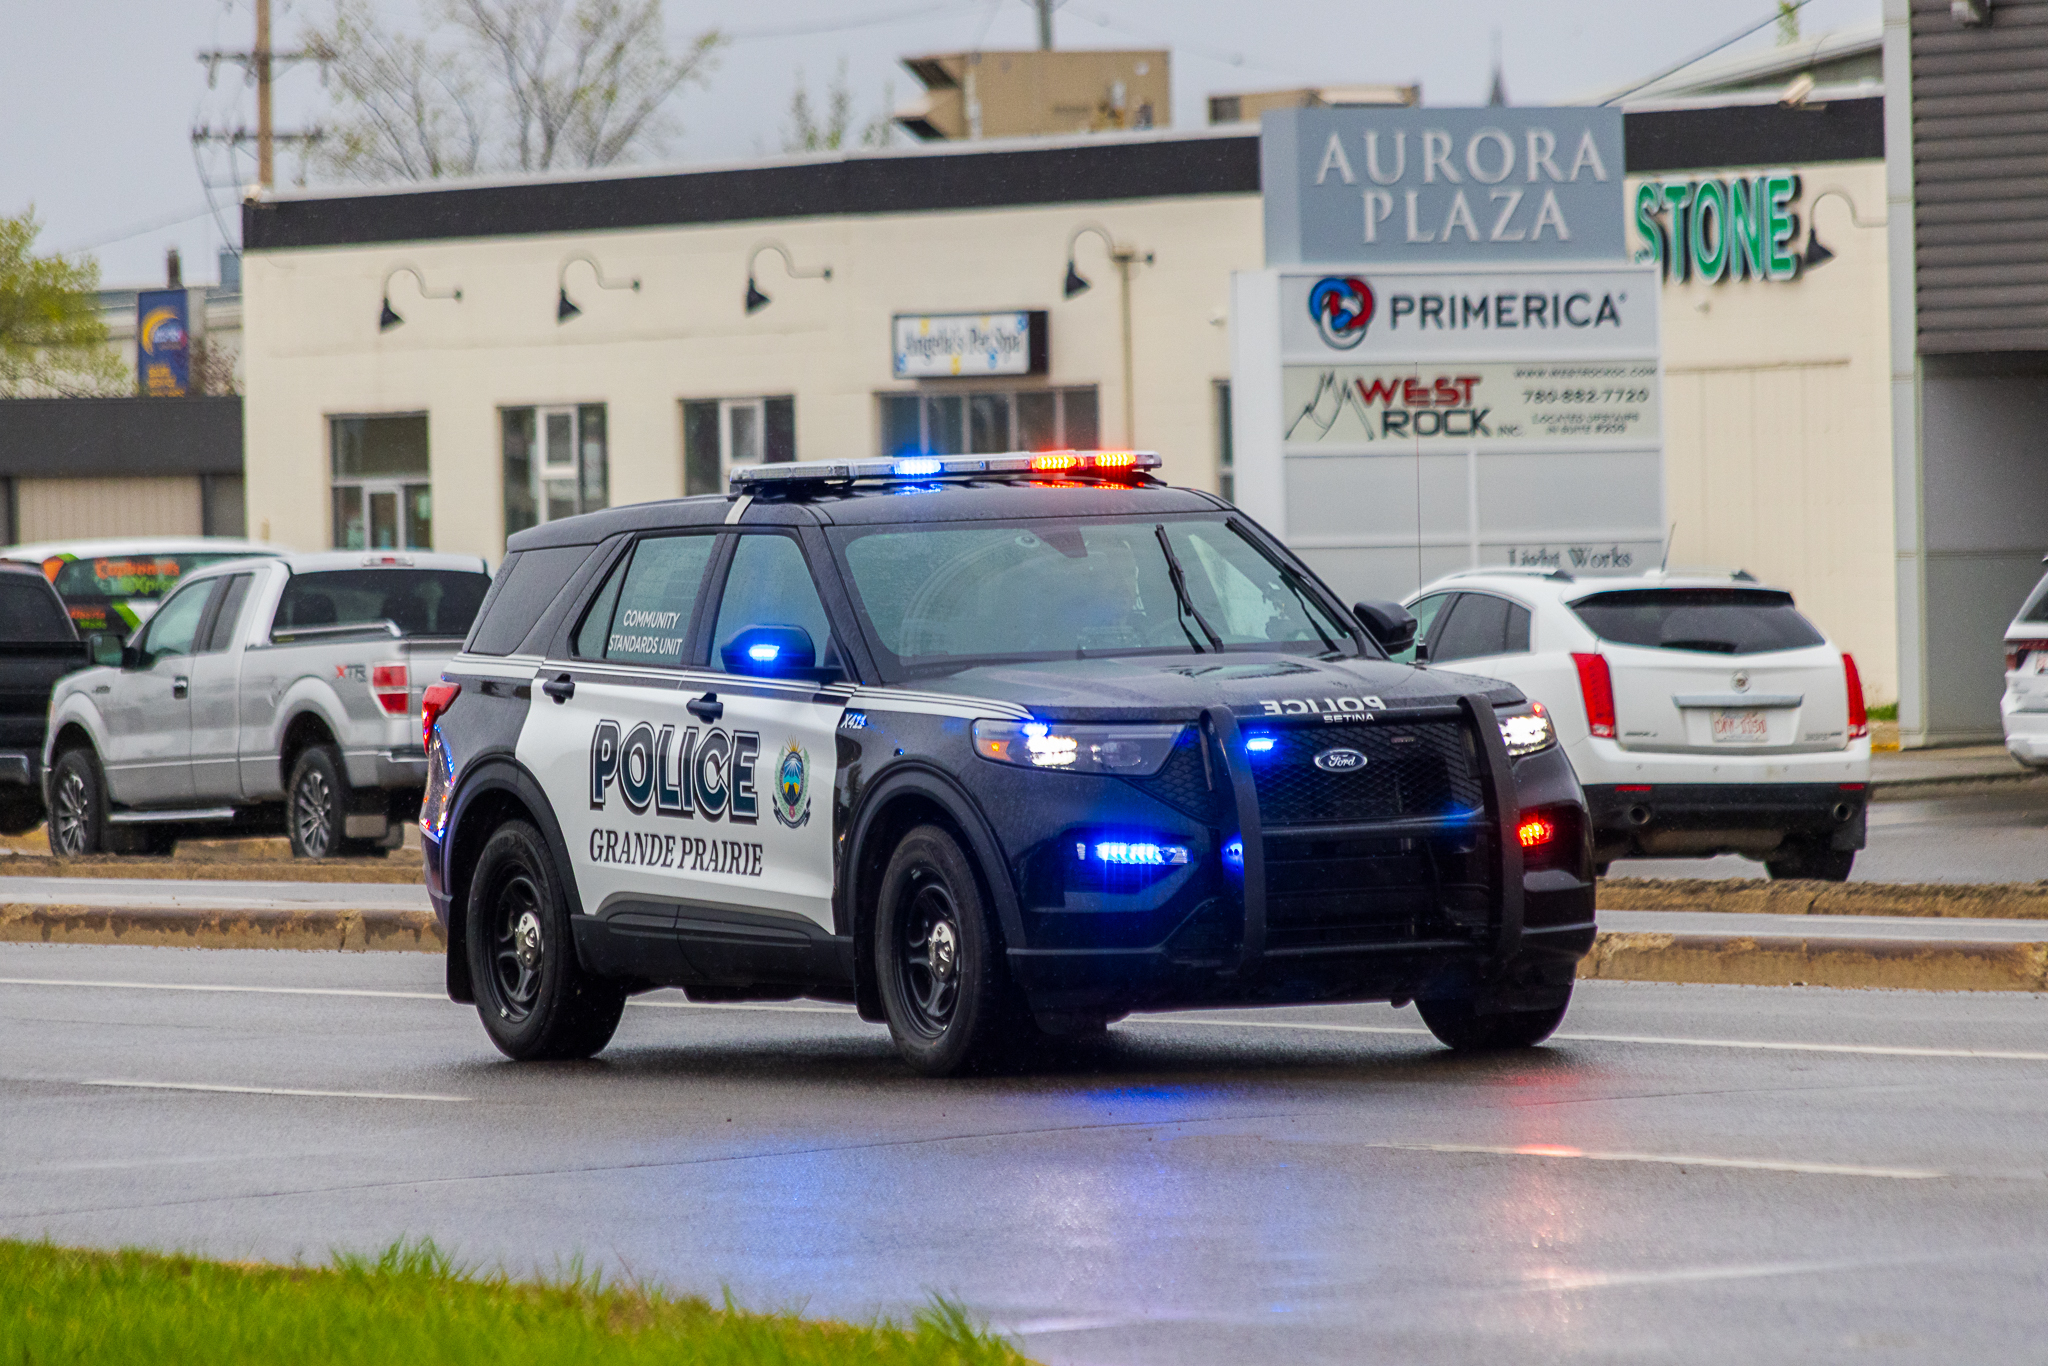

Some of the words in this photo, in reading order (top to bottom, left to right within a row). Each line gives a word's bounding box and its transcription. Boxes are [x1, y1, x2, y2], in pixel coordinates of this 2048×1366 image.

[1315, 126, 1608, 186] AURORA
[1361, 188, 1573, 244] PLAZA
[1634, 174, 1800, 286] STONE
[1353, 375, 1483, 408] WEST
[1380, 407, 1493, 439] ROCK
[1567, 546, 1633, 569] Works
[622, 609, 681, 629] COMMUNITY
[608, 634, 659, 654] STANDARDS
[659, 637, 683, 656] UNIT
[1323, 712, 1375, 724] SETINA
[589, 718, 761, 826] POLICE
[1328, 754, 1356, 768] Ford
[589, 827, 676, 868] GRANDE
[677, 836, 764, 877] PRAIRIE
